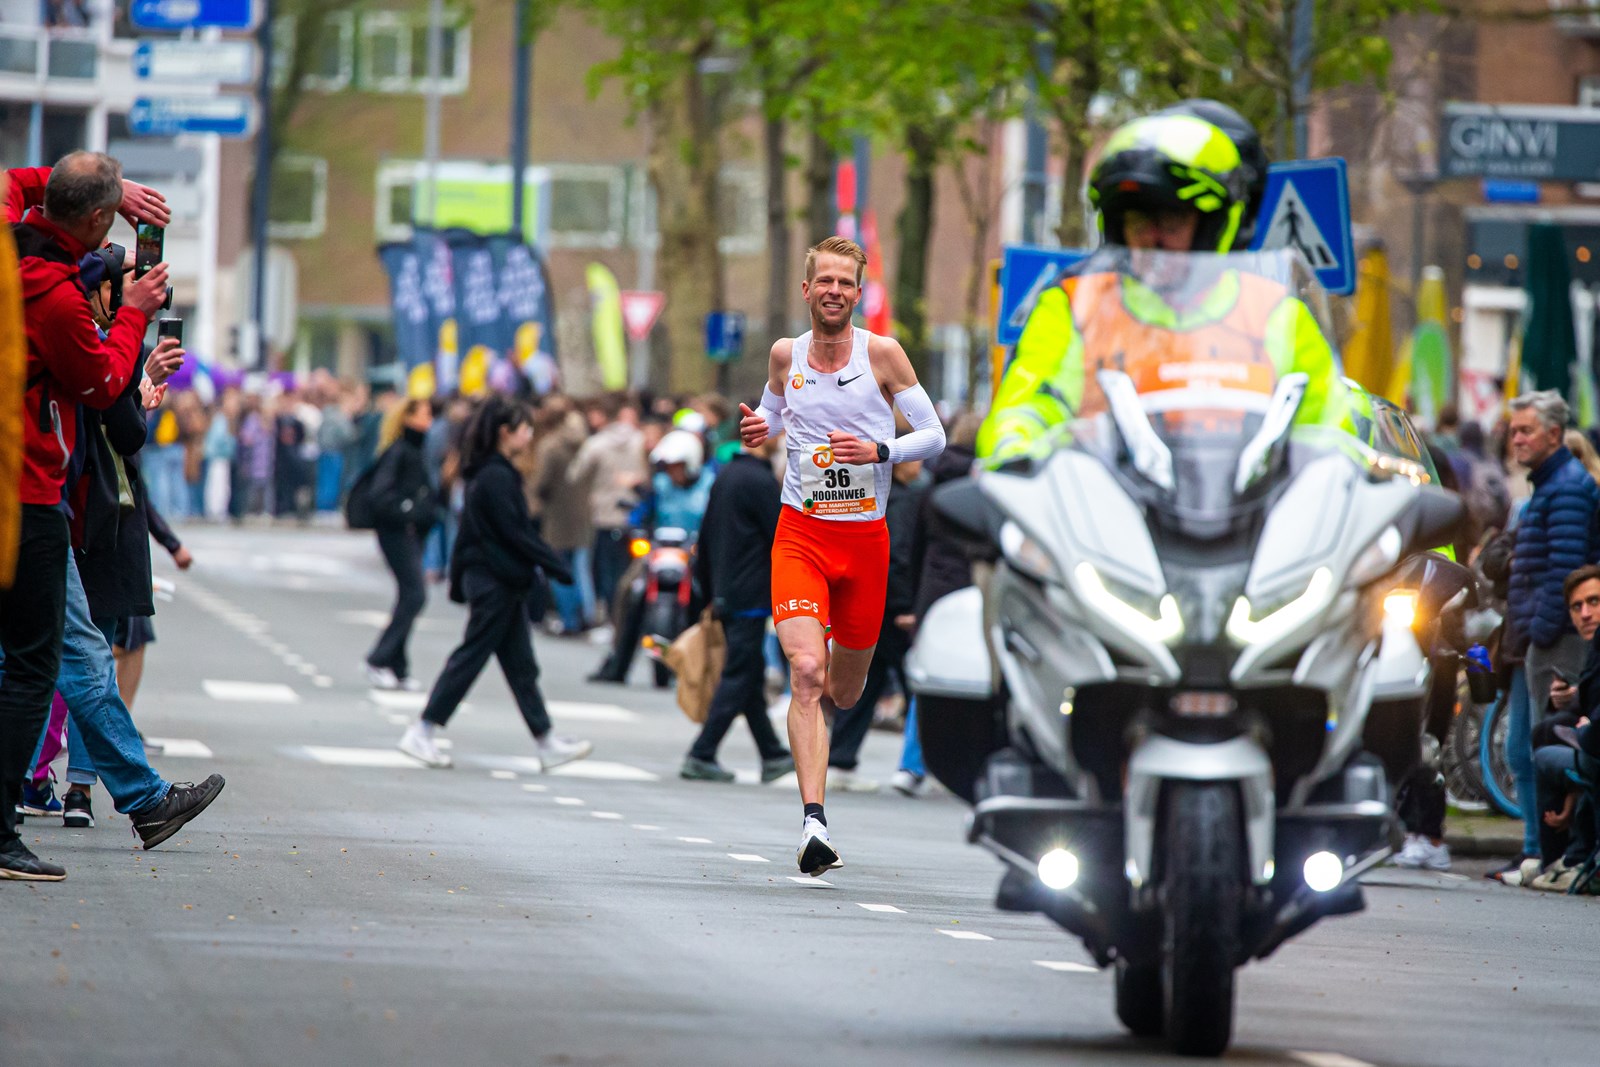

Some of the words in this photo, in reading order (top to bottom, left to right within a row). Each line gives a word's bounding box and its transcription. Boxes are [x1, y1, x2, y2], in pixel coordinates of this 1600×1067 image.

[1450, 116, 1557, 158] GINVI
[824, 468, 851, 488] 36
[812, 488, 866, 501] HOORNWEG
[775, 599, 819, 615] INEOS
